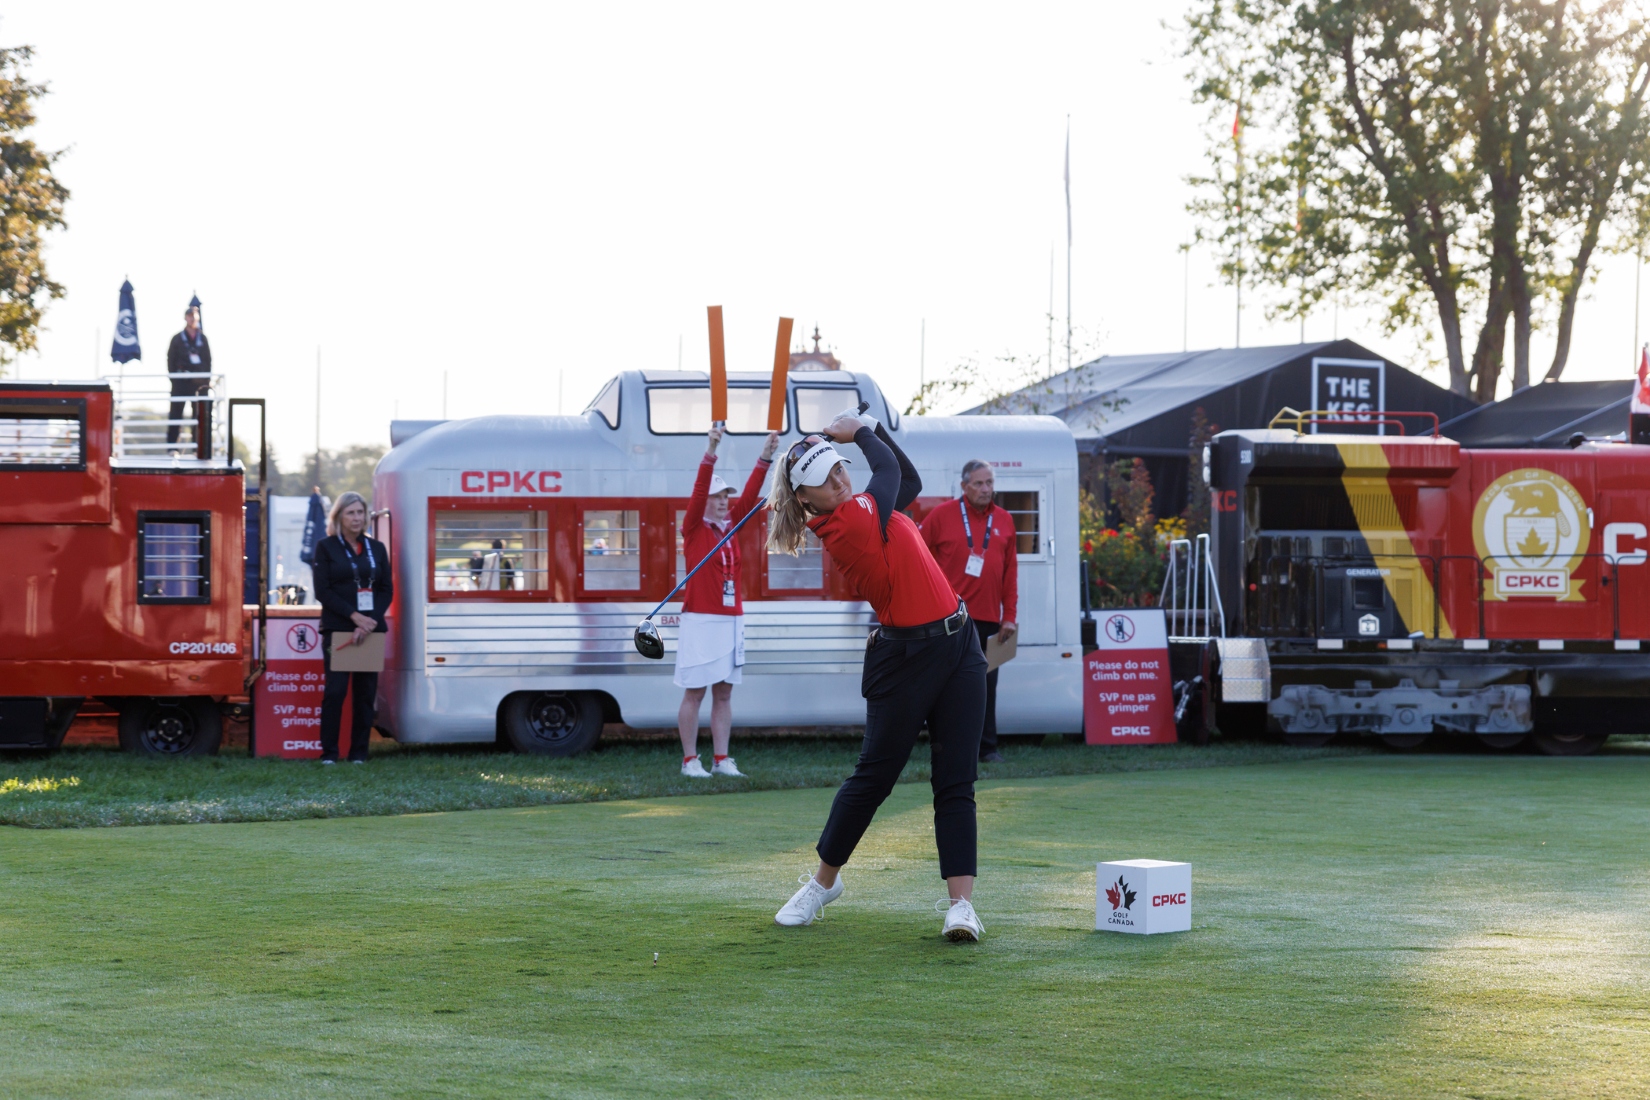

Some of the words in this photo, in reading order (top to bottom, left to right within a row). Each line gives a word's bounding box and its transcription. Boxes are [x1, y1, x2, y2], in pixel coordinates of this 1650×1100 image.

[1326, 376, 1371, 399] THE
[1327, 401, 1371, 422] KEG
[801, 446, 833, 473] SKECHERS
[461, 470, 563, 493] CPKC
[1346, 568, 1391, 576] GENERATOR
[1505, 575, 1560, 588] CPKC
[169, 642, 237, 654] CP201406
[1089, 661, 1122, 670] Please
[1124, 660, 1138, 670] do
[1141, 660, 1159, 669] not
[266, 672, 300, 681] Please
[303, 672, 318, 681] do
[1092, 671, 1120, 680] climb
[1139, 672, 1158, 680] me.
[268, 683, 298, 692] climb
[300, 684, 315, 692] on
[1100, 692, 1119, 702] SVP
[1138, 694, 1156, 702] pas
[273, 705, 295, 714] SVP
[298, 706, 312, 714] ne
[1108, 703, 1149, 714] grimper
[282, 716, 321, 728] grimpe
[1111, 726, 1151, 736] CPKC
[1152, 893, 1187, 908] CPKC
[1107, 918, 1135, 926] CANADA
